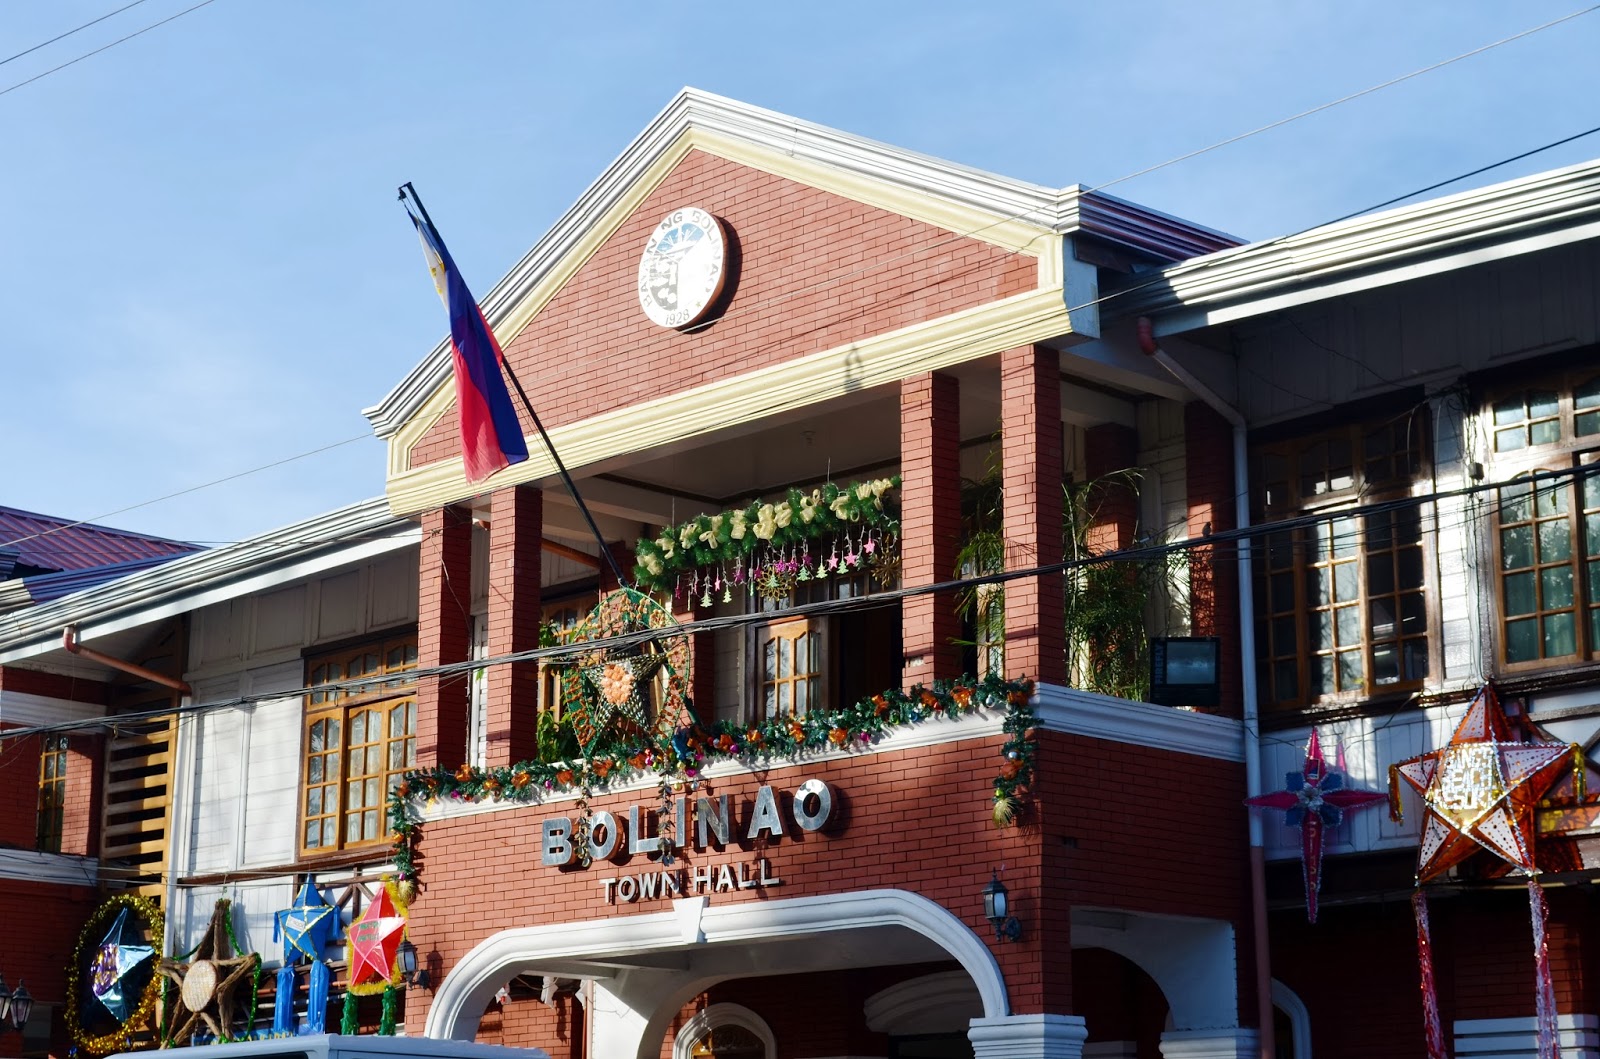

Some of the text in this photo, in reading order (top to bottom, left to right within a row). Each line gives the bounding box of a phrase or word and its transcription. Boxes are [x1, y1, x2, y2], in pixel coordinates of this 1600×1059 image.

[661, 212, 682, 230] NG
[693, 211, 721, 292] BOLINAO
[665, 309, 690, 325] 1928
[1154, 643, 1164, 685] FIREFLY
[541, 778, 836, 866] BOLINAO
[599, 858, 780, 904] TOWN HALL
